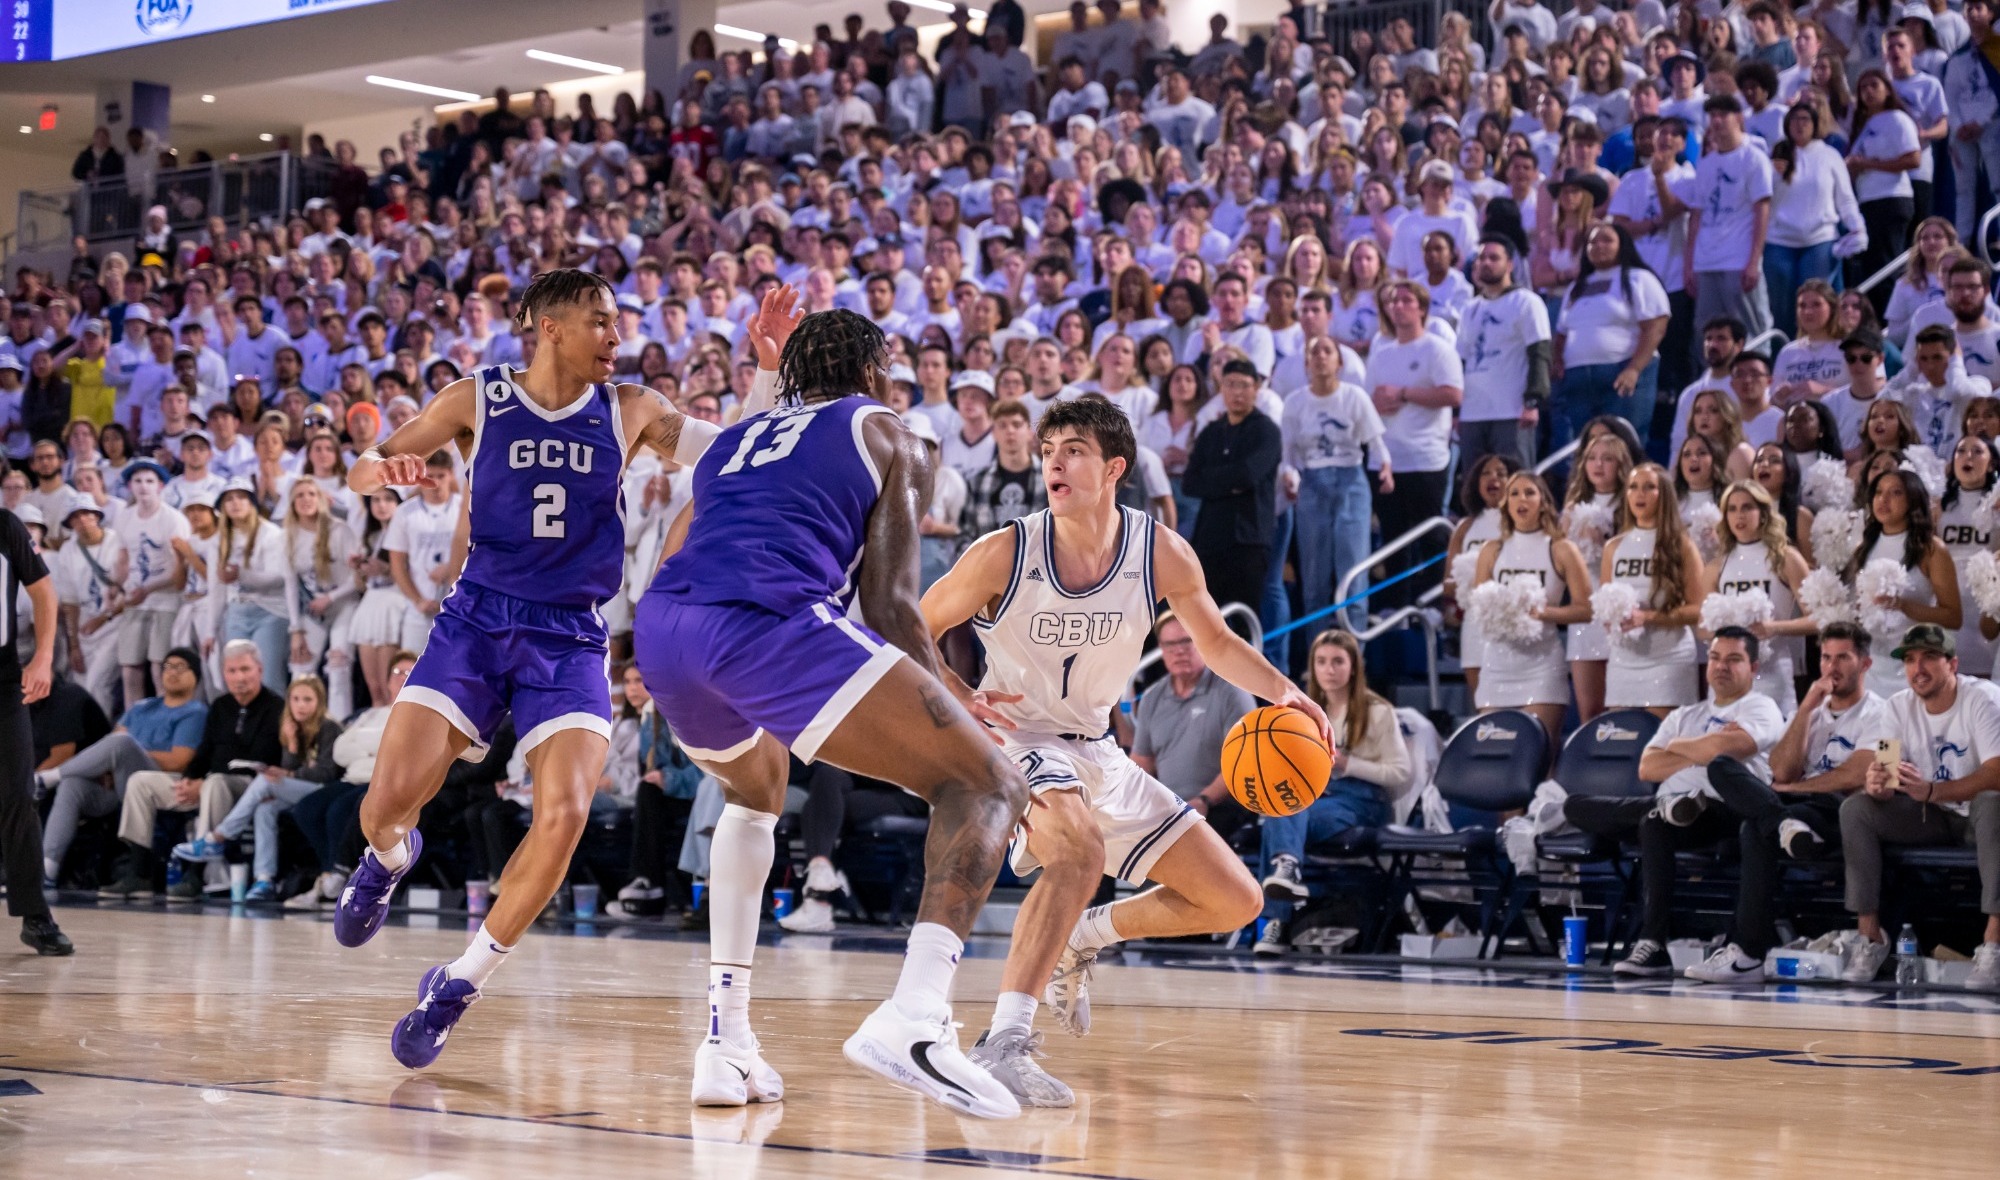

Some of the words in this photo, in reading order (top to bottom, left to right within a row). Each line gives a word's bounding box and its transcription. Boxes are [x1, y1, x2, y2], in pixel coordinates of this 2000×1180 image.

[493, 384, 504, 399] 4
[509, 438, 594, 475] GCU
[717, 412, 818, 477] 13
[532, 483, 567, 539] 2
[1942, 525, 1991, 545] CBU
[1029, 611, 1123, 648] CBU
[1060, 652, 1078, 700] 1
